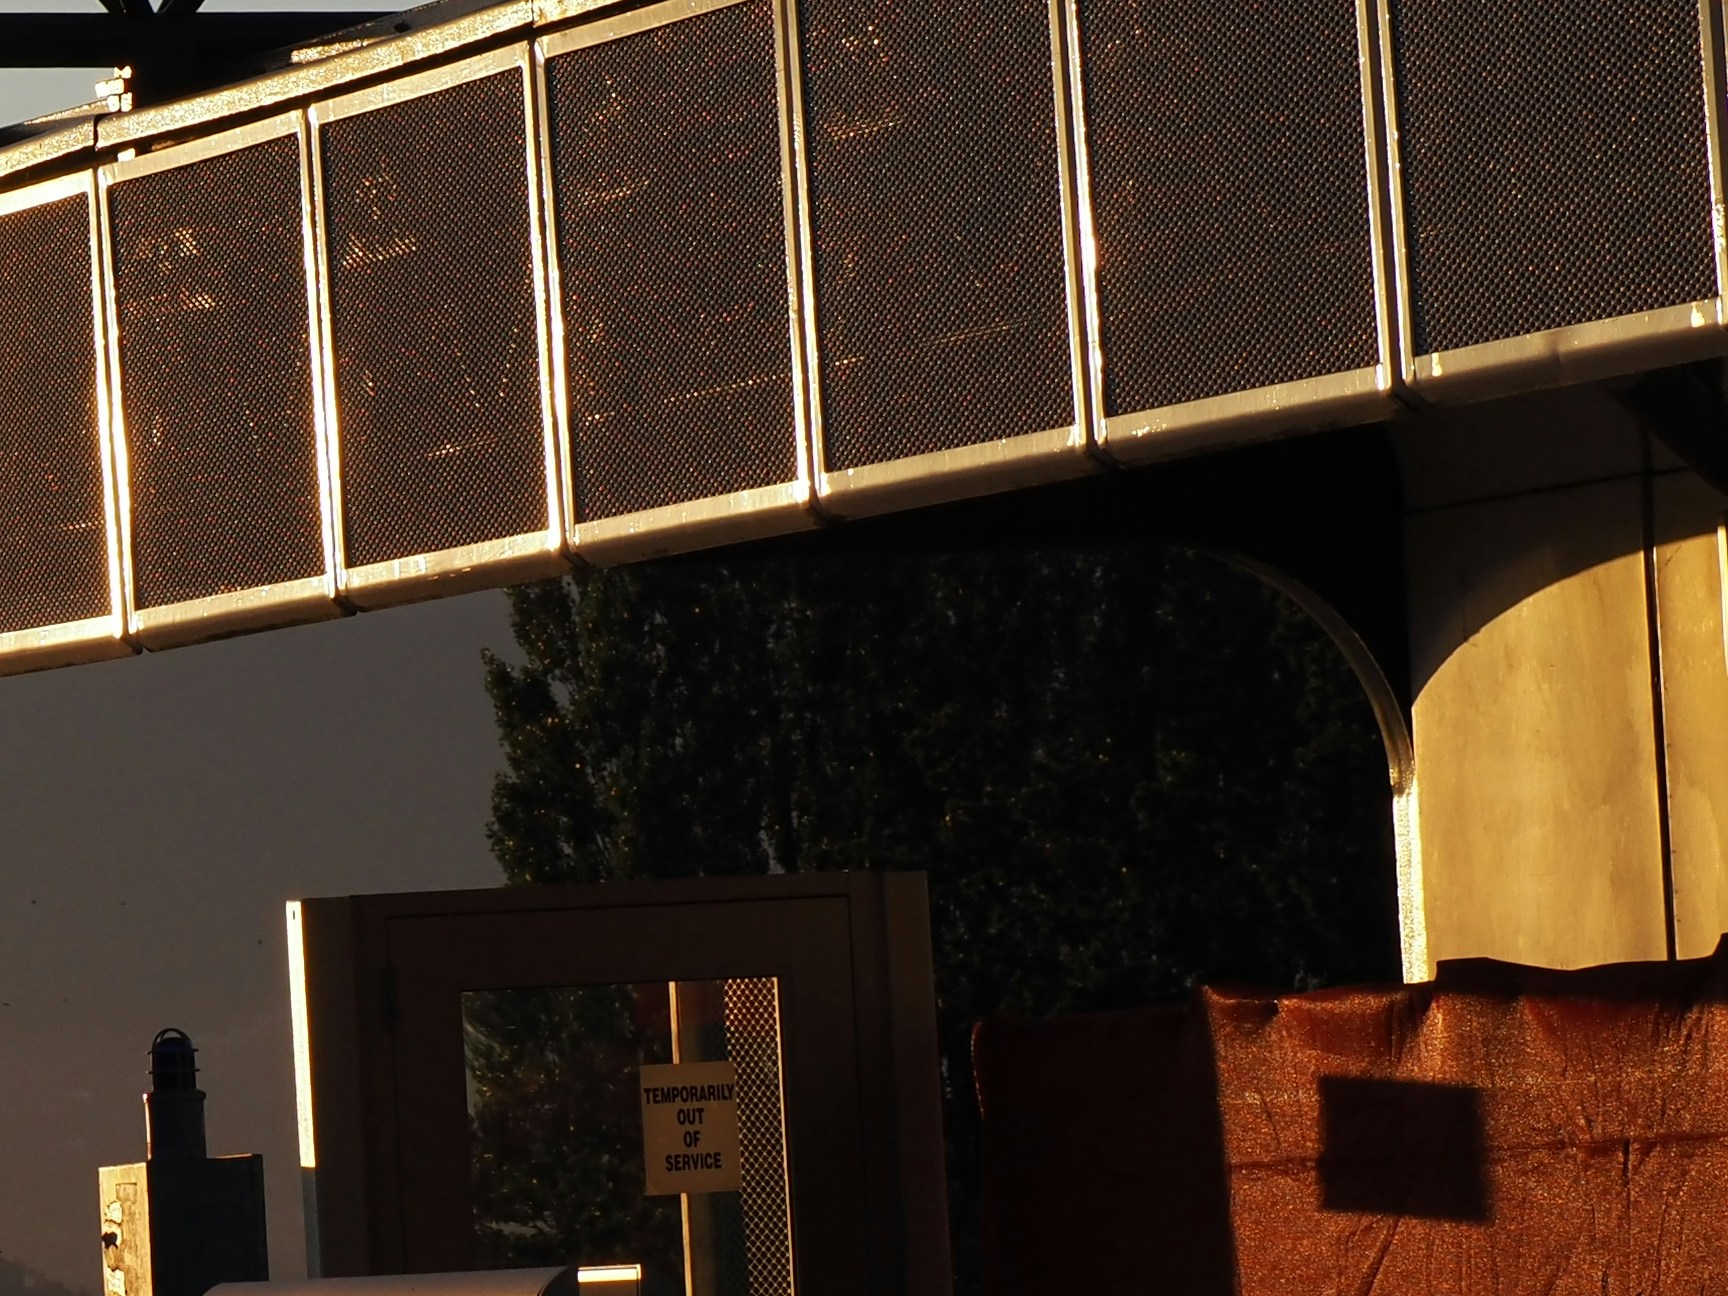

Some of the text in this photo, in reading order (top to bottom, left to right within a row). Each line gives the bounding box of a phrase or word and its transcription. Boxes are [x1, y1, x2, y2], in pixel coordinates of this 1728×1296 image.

[644, 1083, 734, 1104] TEMPORARILY
[677, 1107, 704, 1125] OUT
[683, 1131, 700, 1147] OF
[665, 1152, 722, 1172] SERVICE
